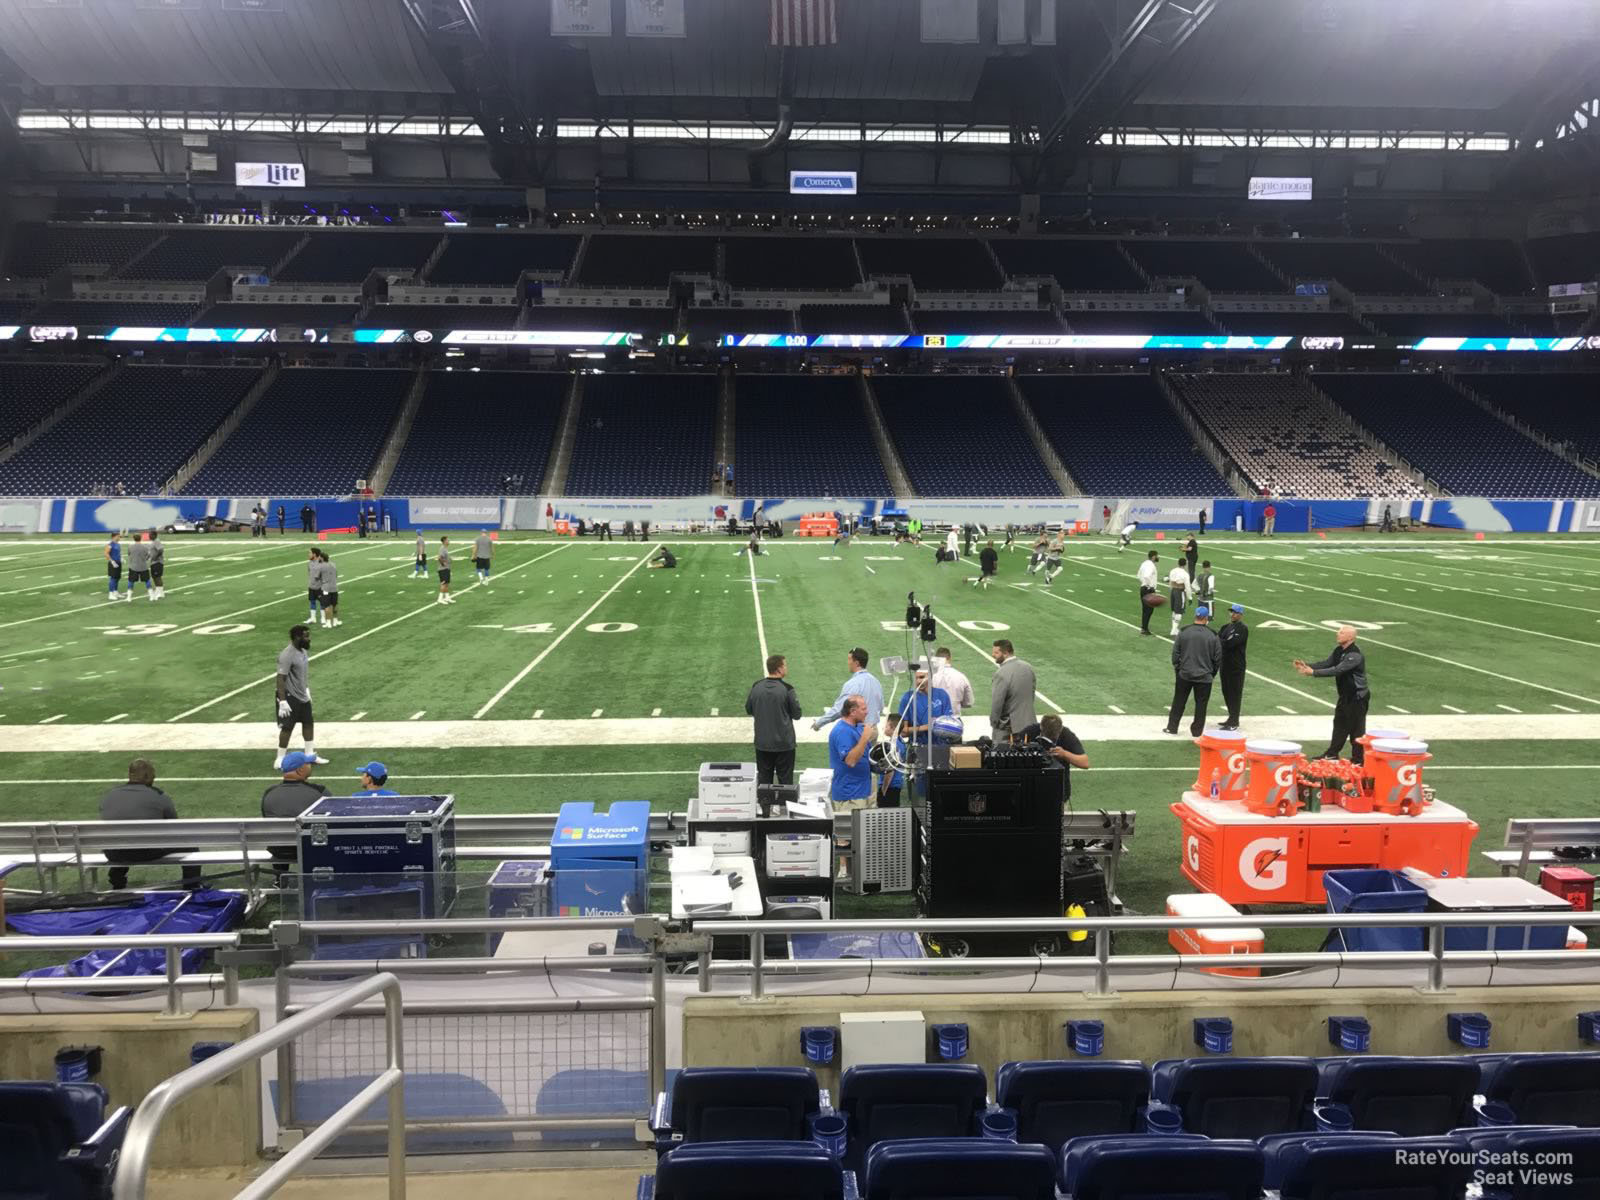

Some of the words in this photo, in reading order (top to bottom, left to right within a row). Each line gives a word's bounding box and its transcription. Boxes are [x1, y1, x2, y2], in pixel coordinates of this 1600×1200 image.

[267, 164, 300, 185] Lite
[785, 335, 808, 346] 0:00
[927, 335, 941, 346] 25
[1228, 753, 1245, 774] G
[1274, 765, 1294, 787] G
[1397, 764, 1417, 786] G
[1187, 835, 1200, 872] G
[1238, 836, 1290, 891] G
[585, 906, 625, 917] Microso
